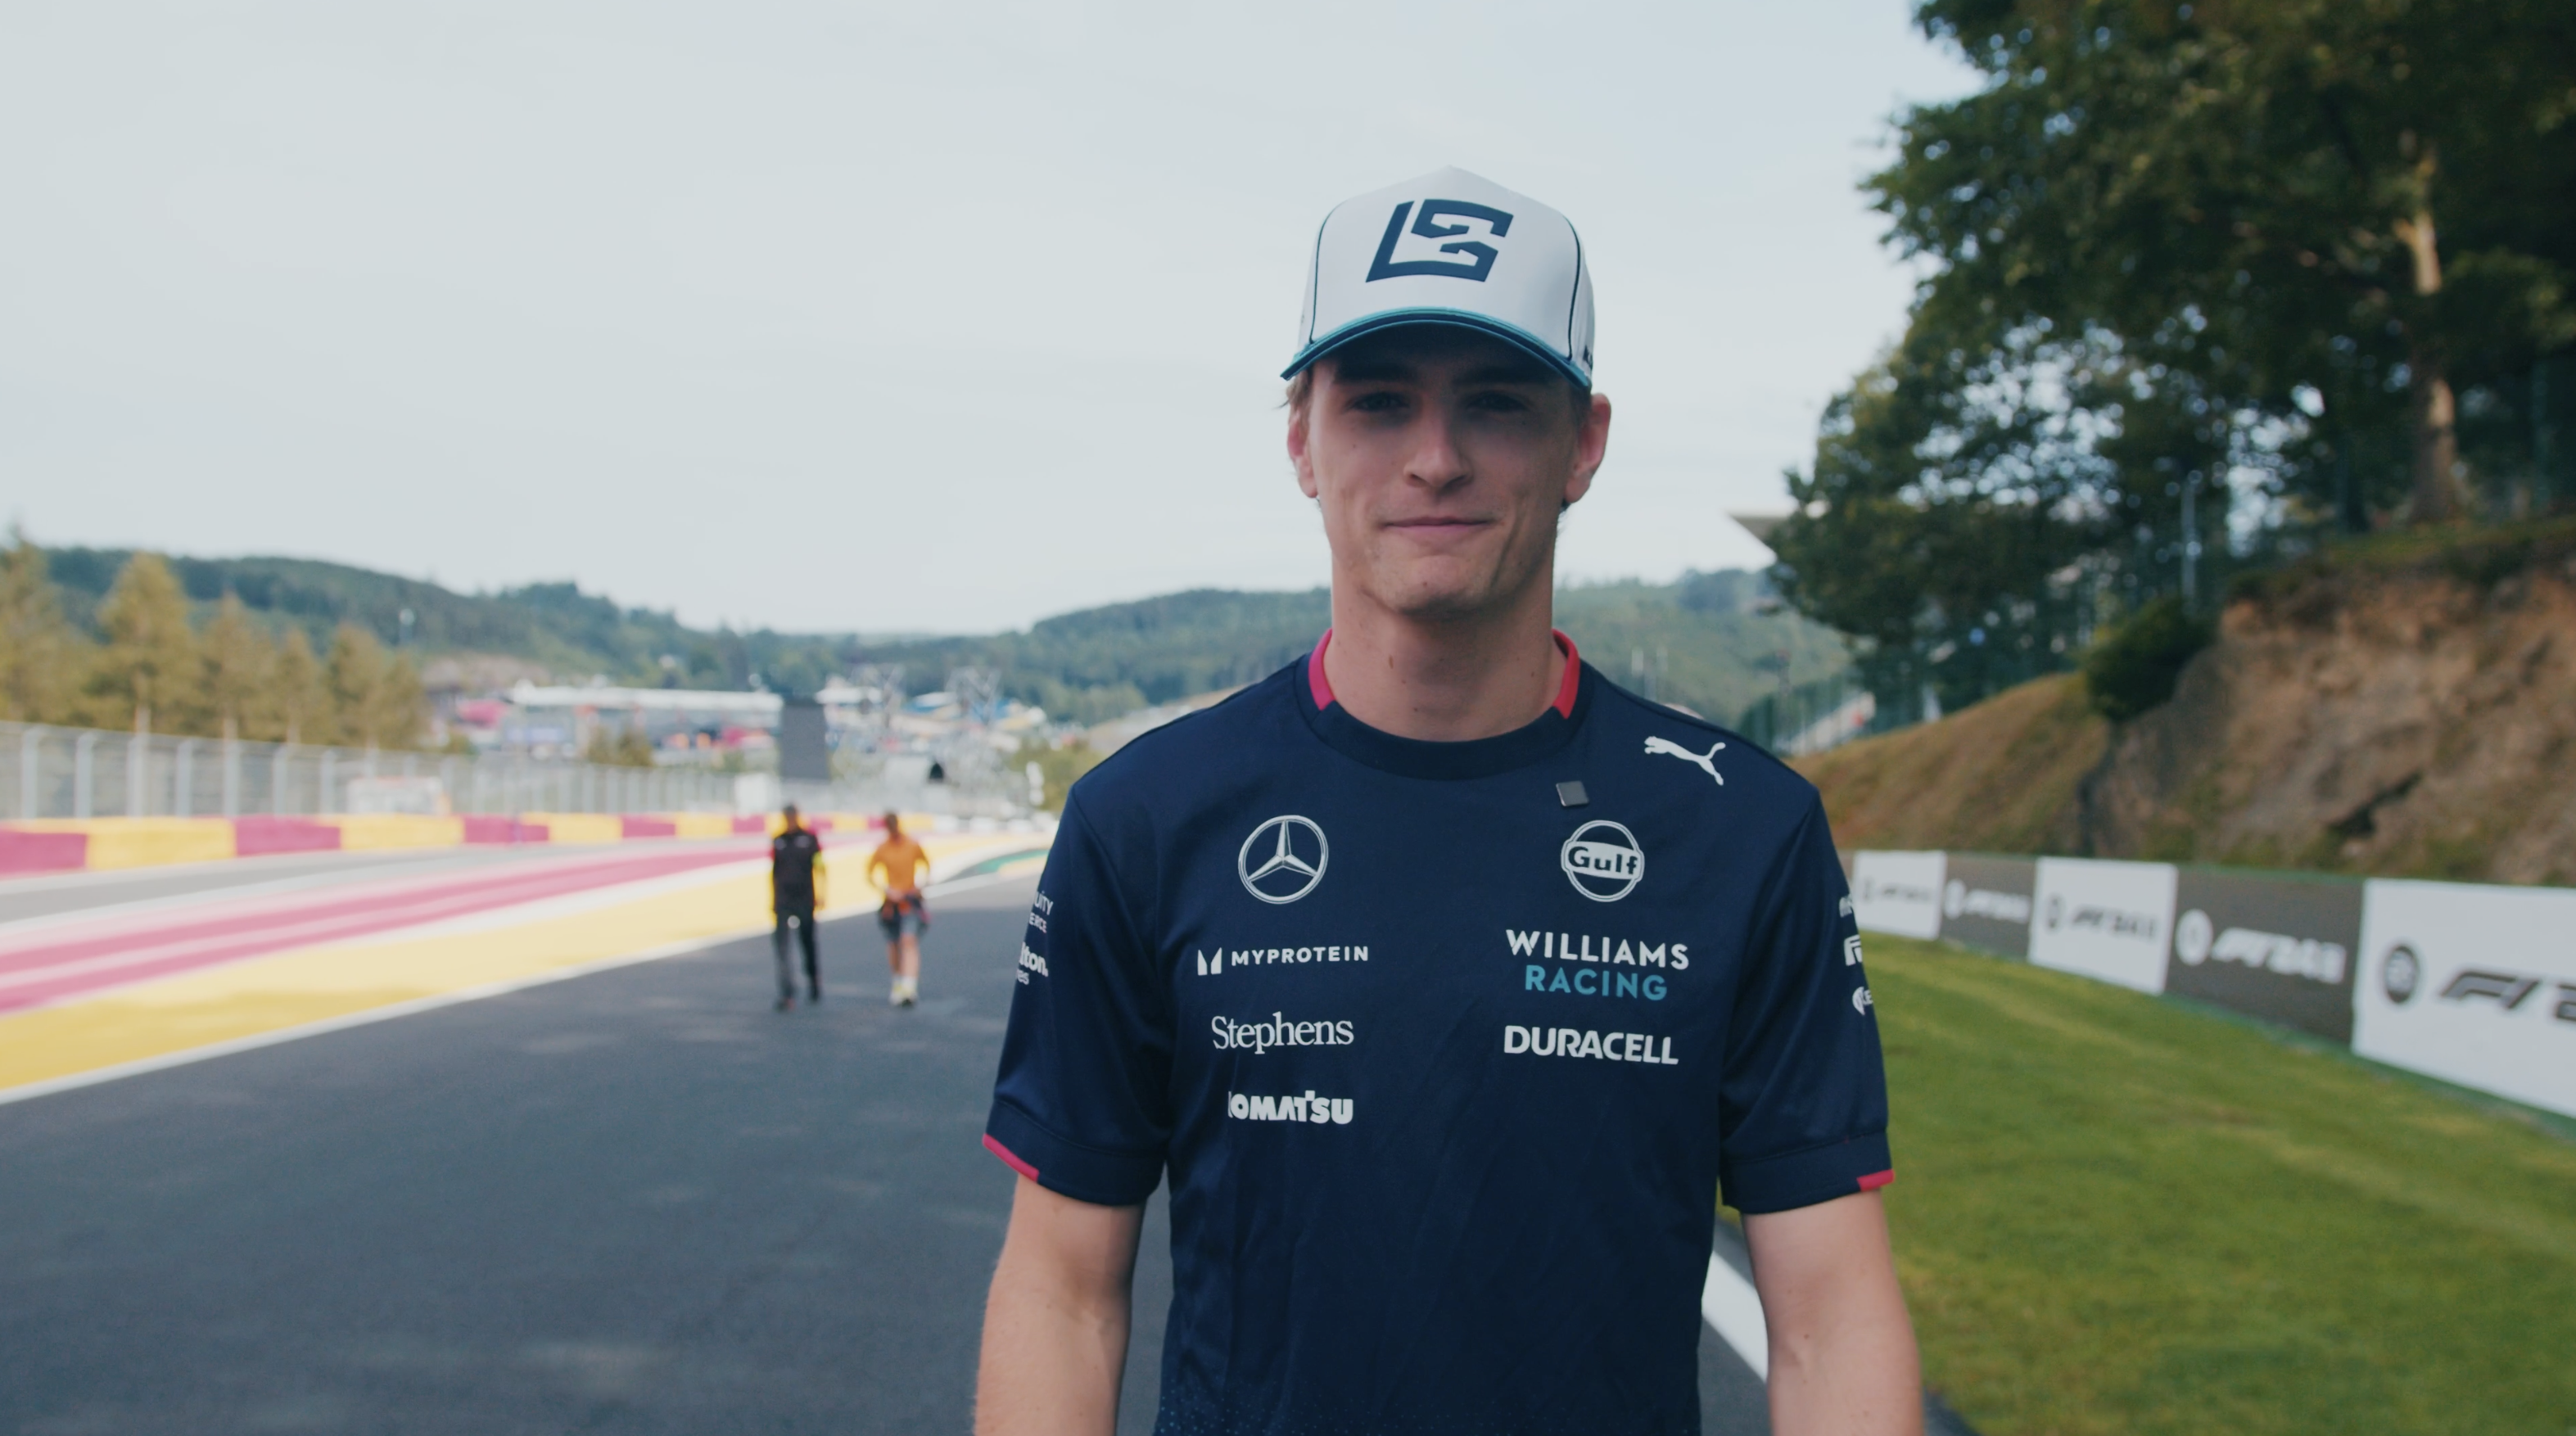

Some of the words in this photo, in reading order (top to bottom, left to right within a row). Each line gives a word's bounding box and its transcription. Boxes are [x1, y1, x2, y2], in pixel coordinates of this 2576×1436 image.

[1567, 846, 1639, 875] Gulf
[1231, 946, 1368, 967] MYPROTEIN
[1506, 929, 1689, 970] WILLIAMS
[1525, 964, 1668, 1001] RACING
[1212, 1010, 1354, 1054] Stephens
[1503, 1025, 1679, 1065] DURACELL
[1228, 1090, 1354, 1125] OMATSU
